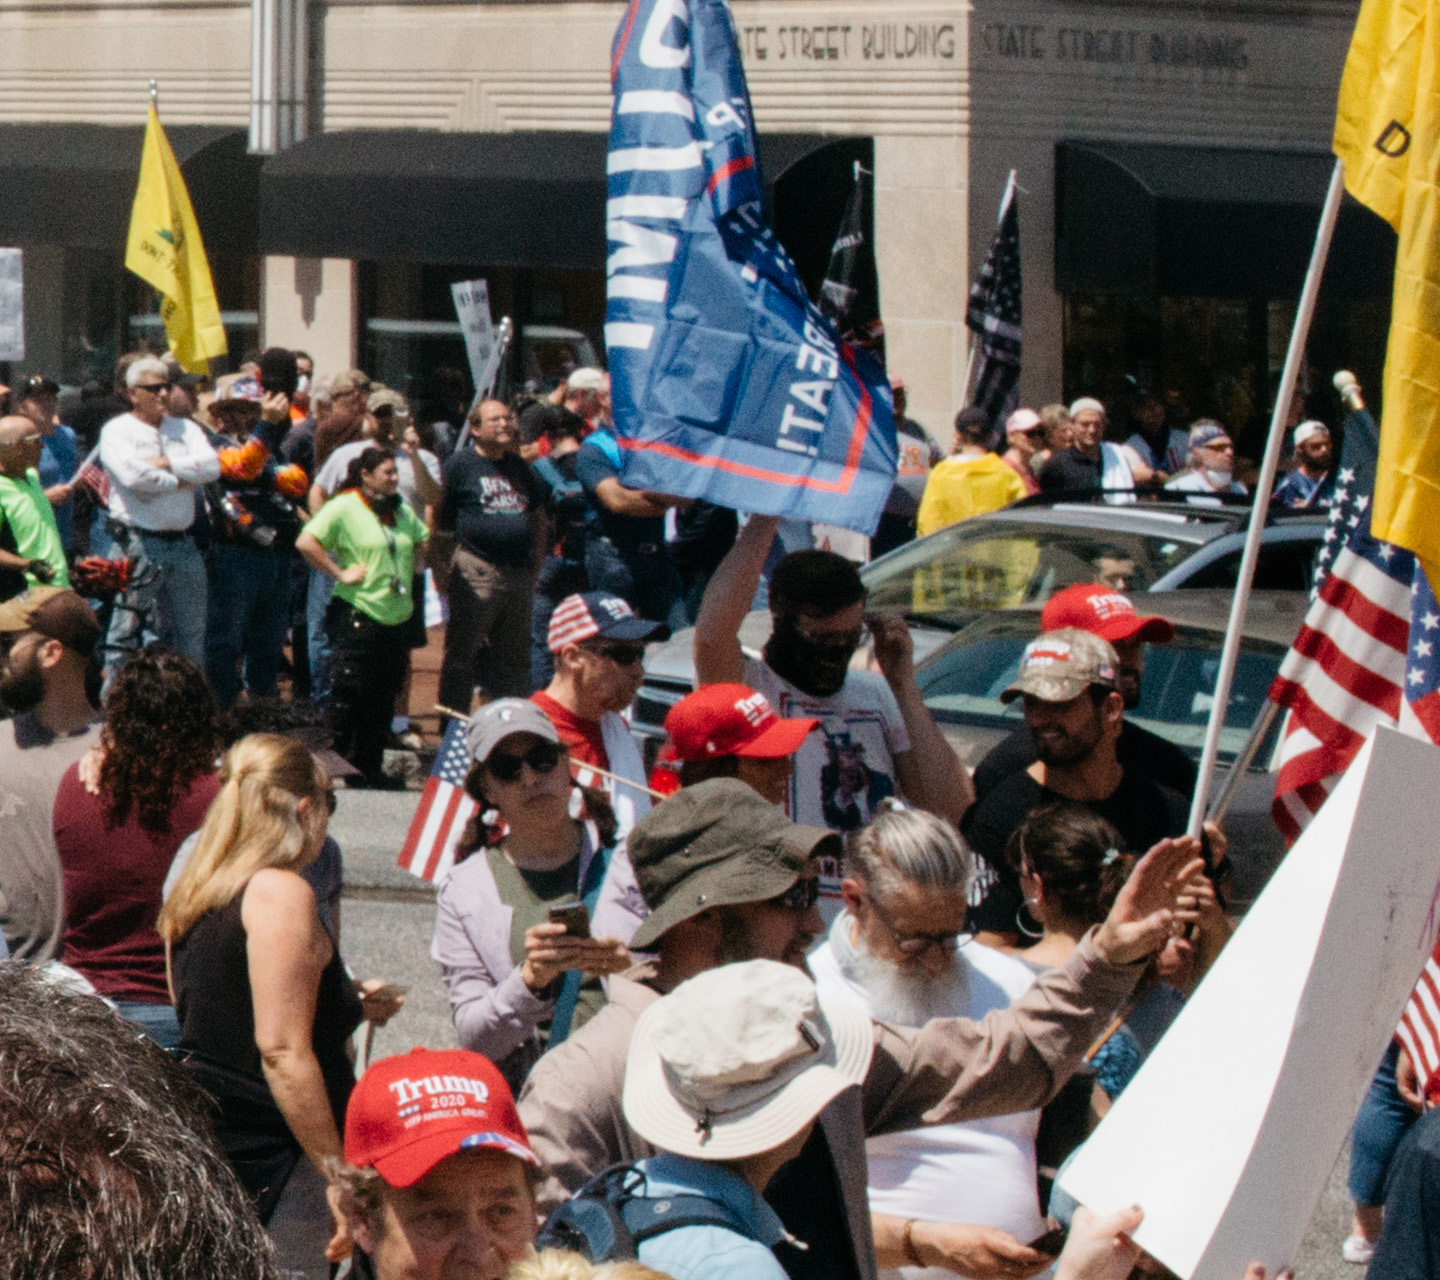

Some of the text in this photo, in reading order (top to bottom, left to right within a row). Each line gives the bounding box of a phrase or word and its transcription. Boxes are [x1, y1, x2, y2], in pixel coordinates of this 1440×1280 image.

[738, 24, 956, 60] TE STREET BUILDING
[982, 23, 1250, 71] STATE STREET BUILDING
[480, 474, 512, 495] BEN
[389, 1075, 489, 1106] Trump
[431, 1094, 466, 1109] 2020
